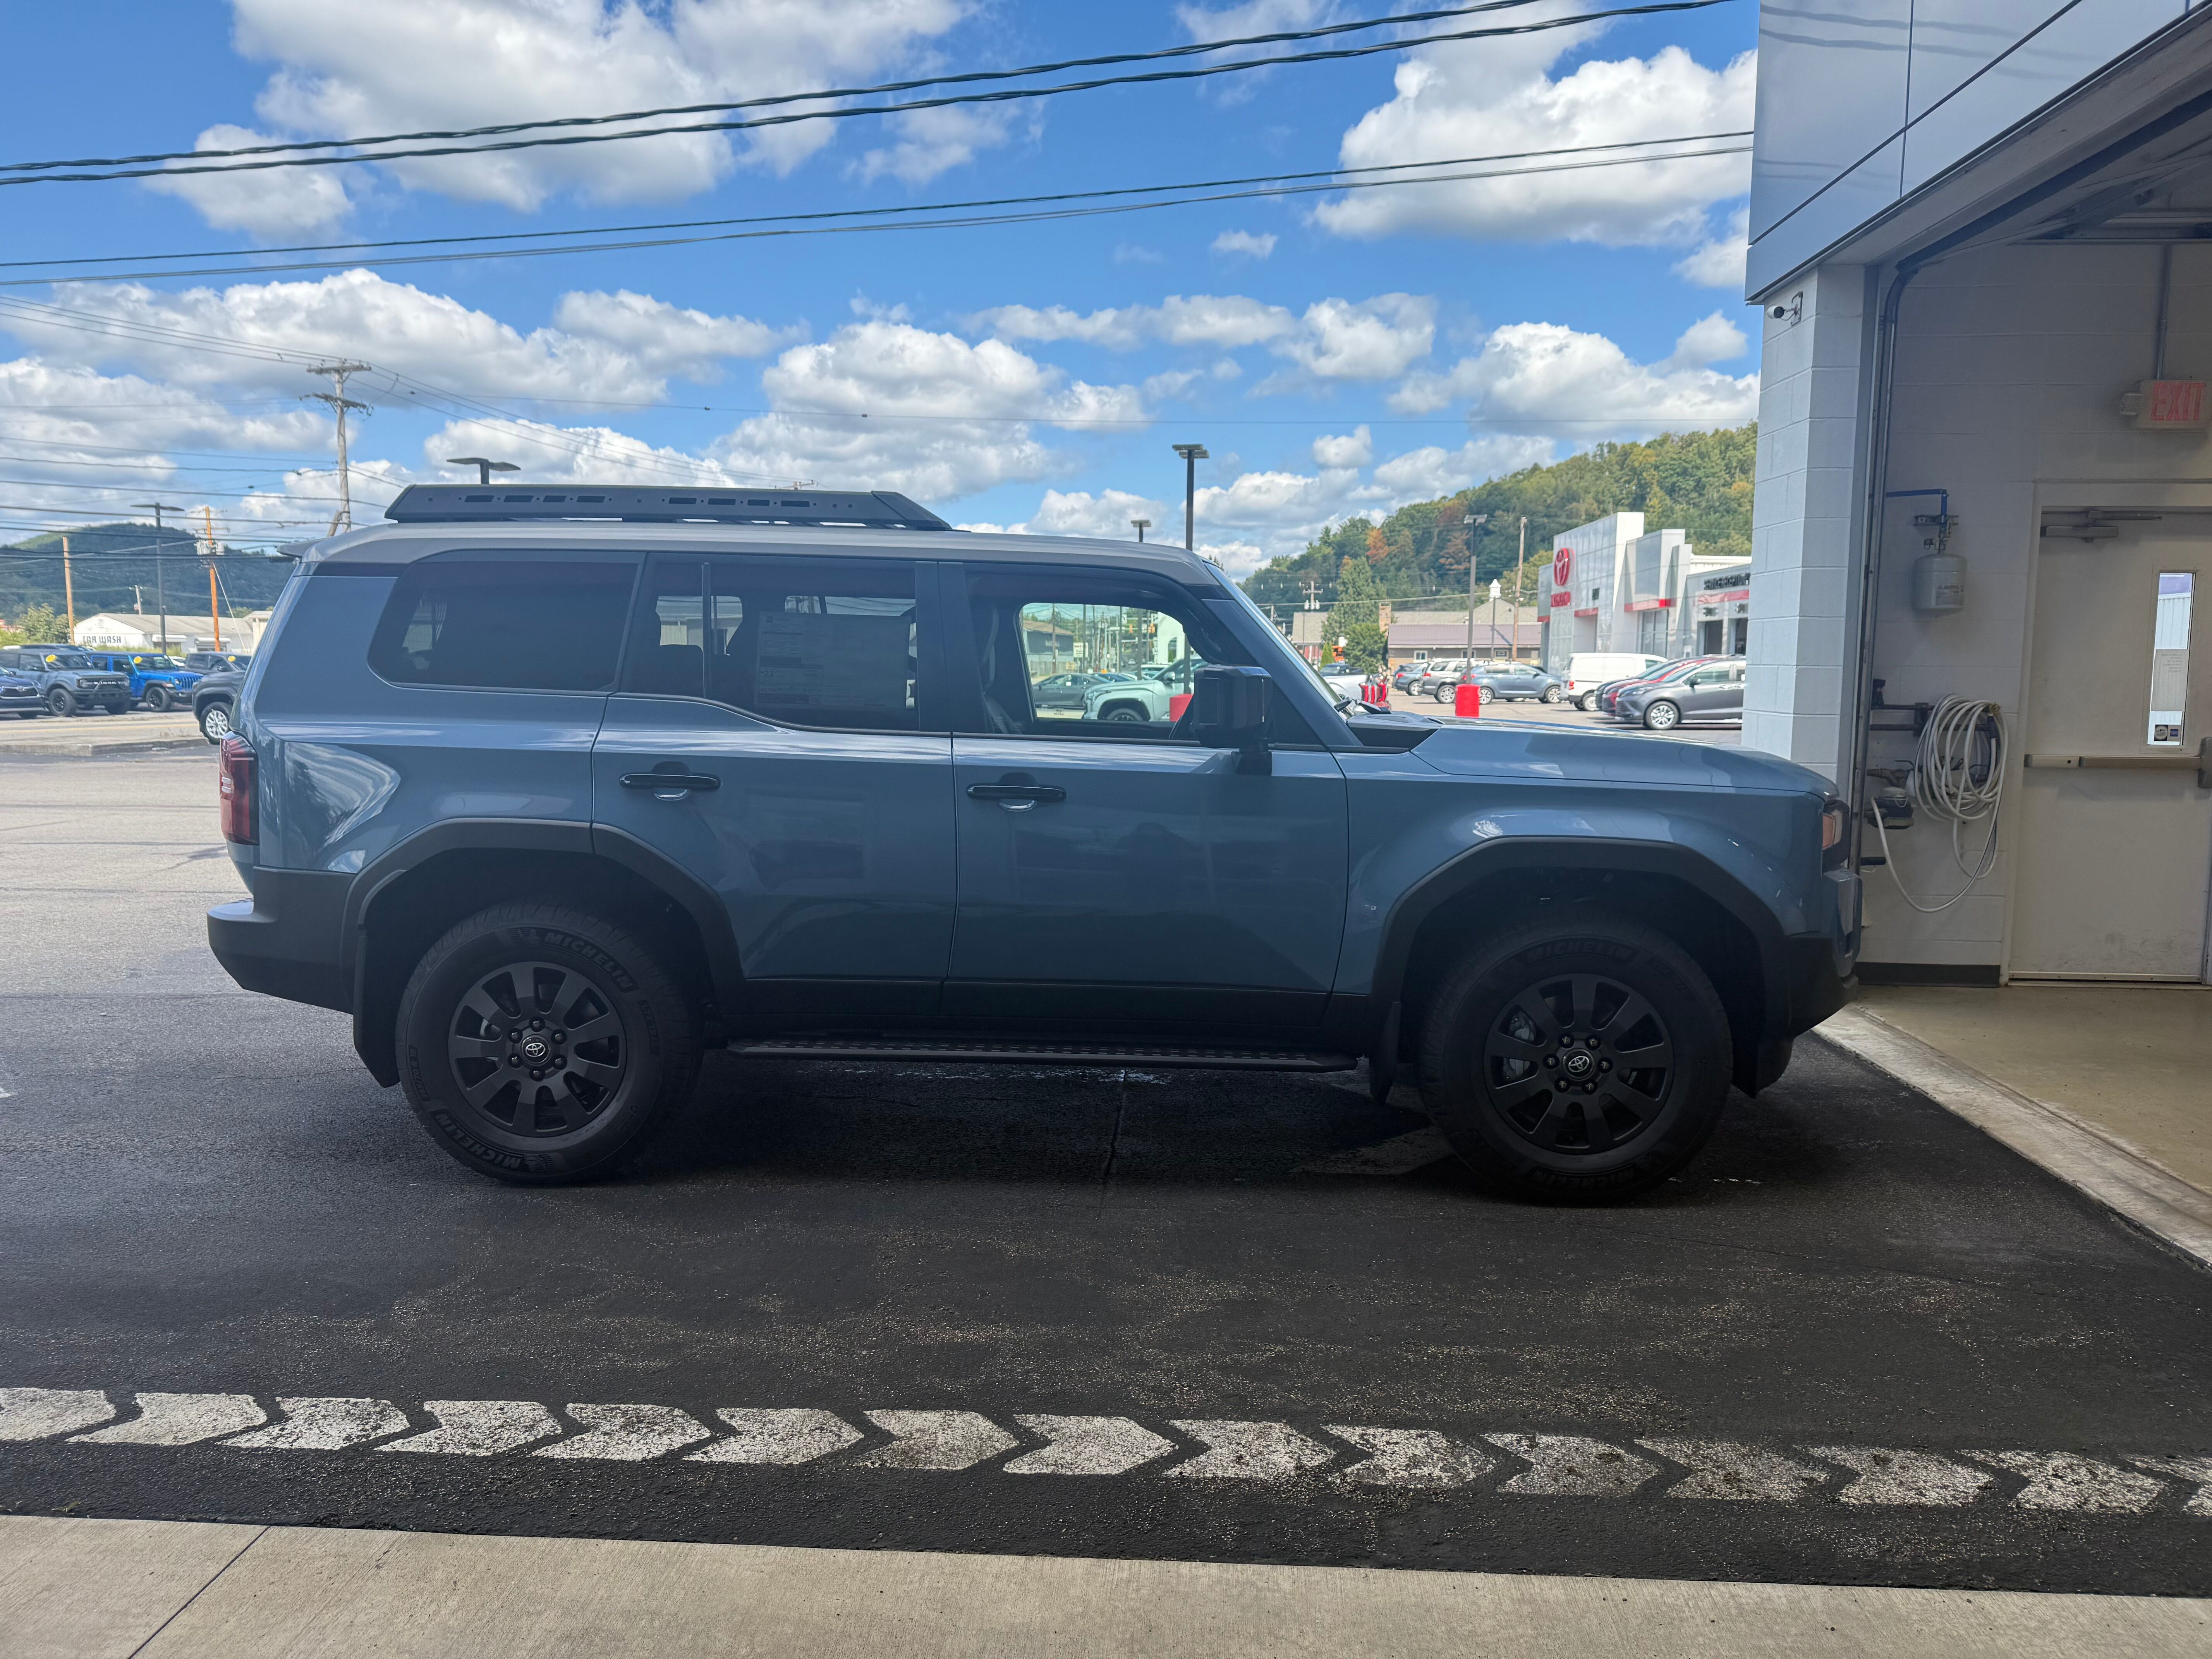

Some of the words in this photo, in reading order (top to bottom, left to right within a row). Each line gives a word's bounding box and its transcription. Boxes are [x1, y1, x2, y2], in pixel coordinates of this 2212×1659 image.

[2151, 382, 2206, 421] EXIT
[544, 932, 633, 989] MICHELIN
[1527, 941, 1633, 963] MICHELIN
[435, 1114, 521, 1169] MICHELIN
